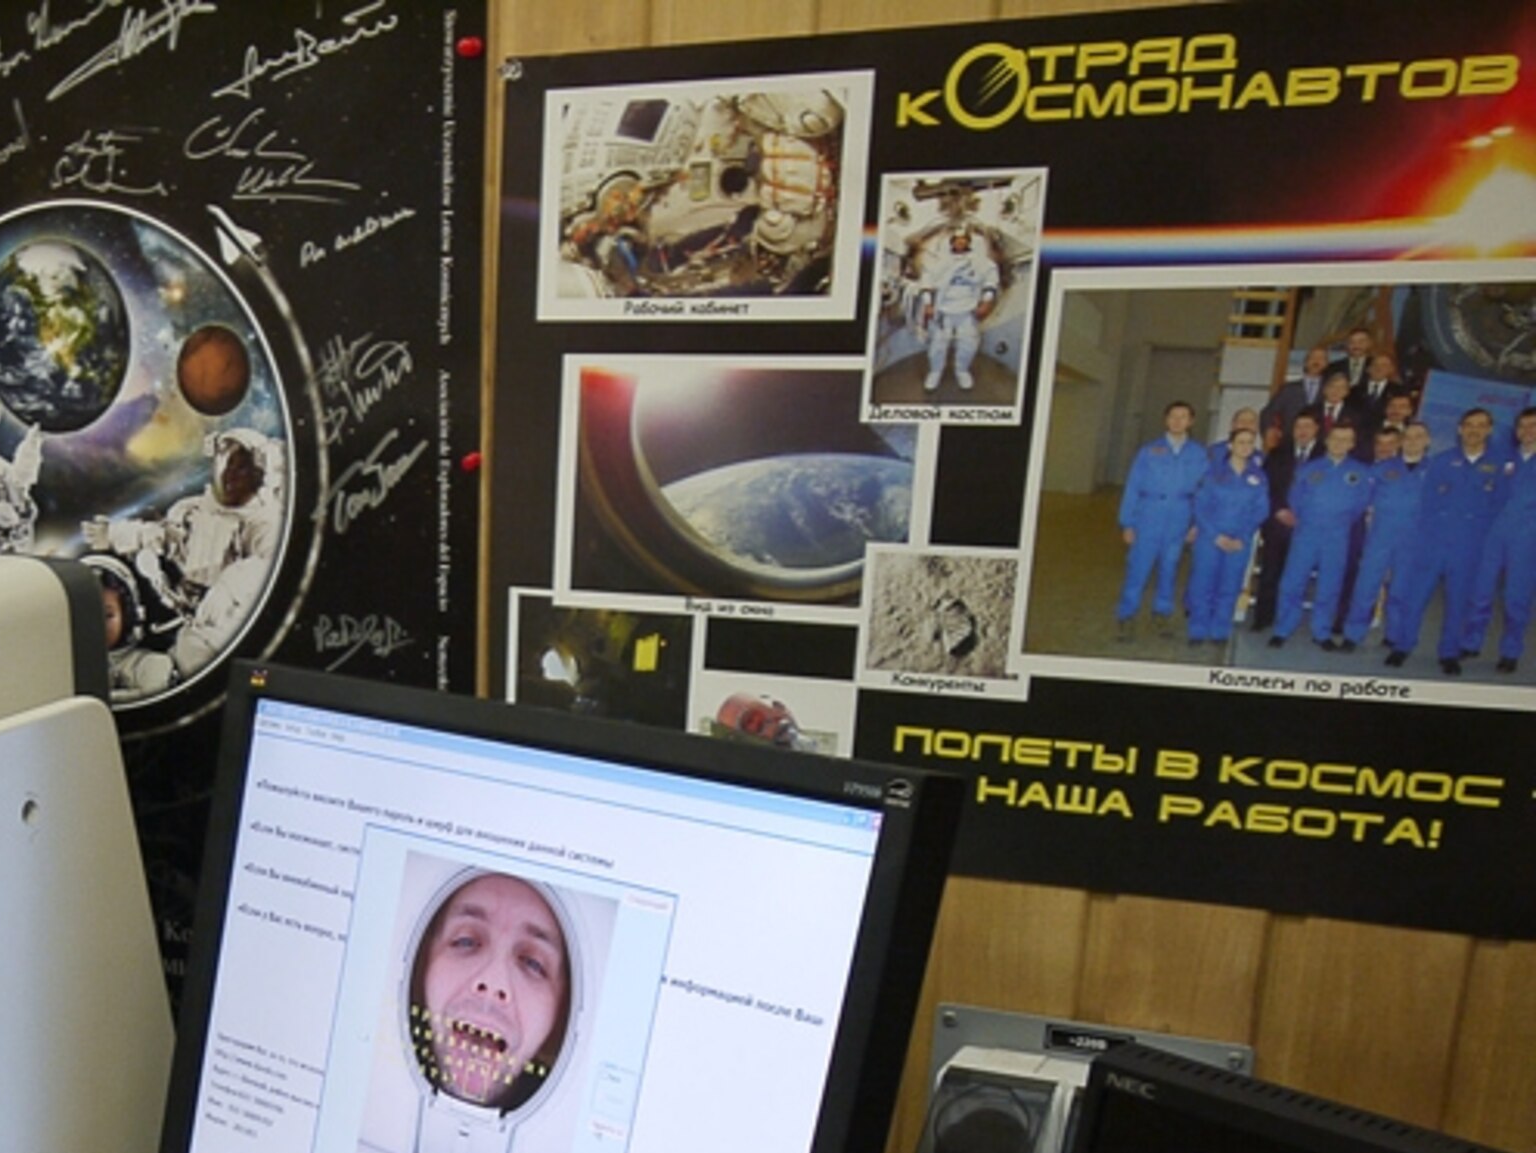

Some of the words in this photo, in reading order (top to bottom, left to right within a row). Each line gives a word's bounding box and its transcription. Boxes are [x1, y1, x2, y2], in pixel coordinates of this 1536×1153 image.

[897, 42, 1519, 128] КОСМОНАВТОВ
[945, 34, 1238, 128] ОТРЯД
[623, 301, 685, 319] Рабочий
[691, 302, 750, 315] кабинет
[869, 404, 941, 420] Деловой
[949, 409, 1012, 421] костюм
[891, 673, 986, 693] Конкуренты
[1209, 669, 1295, 690] Коллеги
[1305, 681, 1332, 693] по
[1339, 681, 1411, 698] работе
[894, 725, 1138, 775] ПОЛЕТЫ
[1155, 750, 1199, 781] В
[1218, 755, 1505, 807] КОСМОС
[976, 776, 1133, 819] НАША
[1158, 794, 1443, 848] РАБОТА!
[1105, 1071, 1157, 1099] NEC
